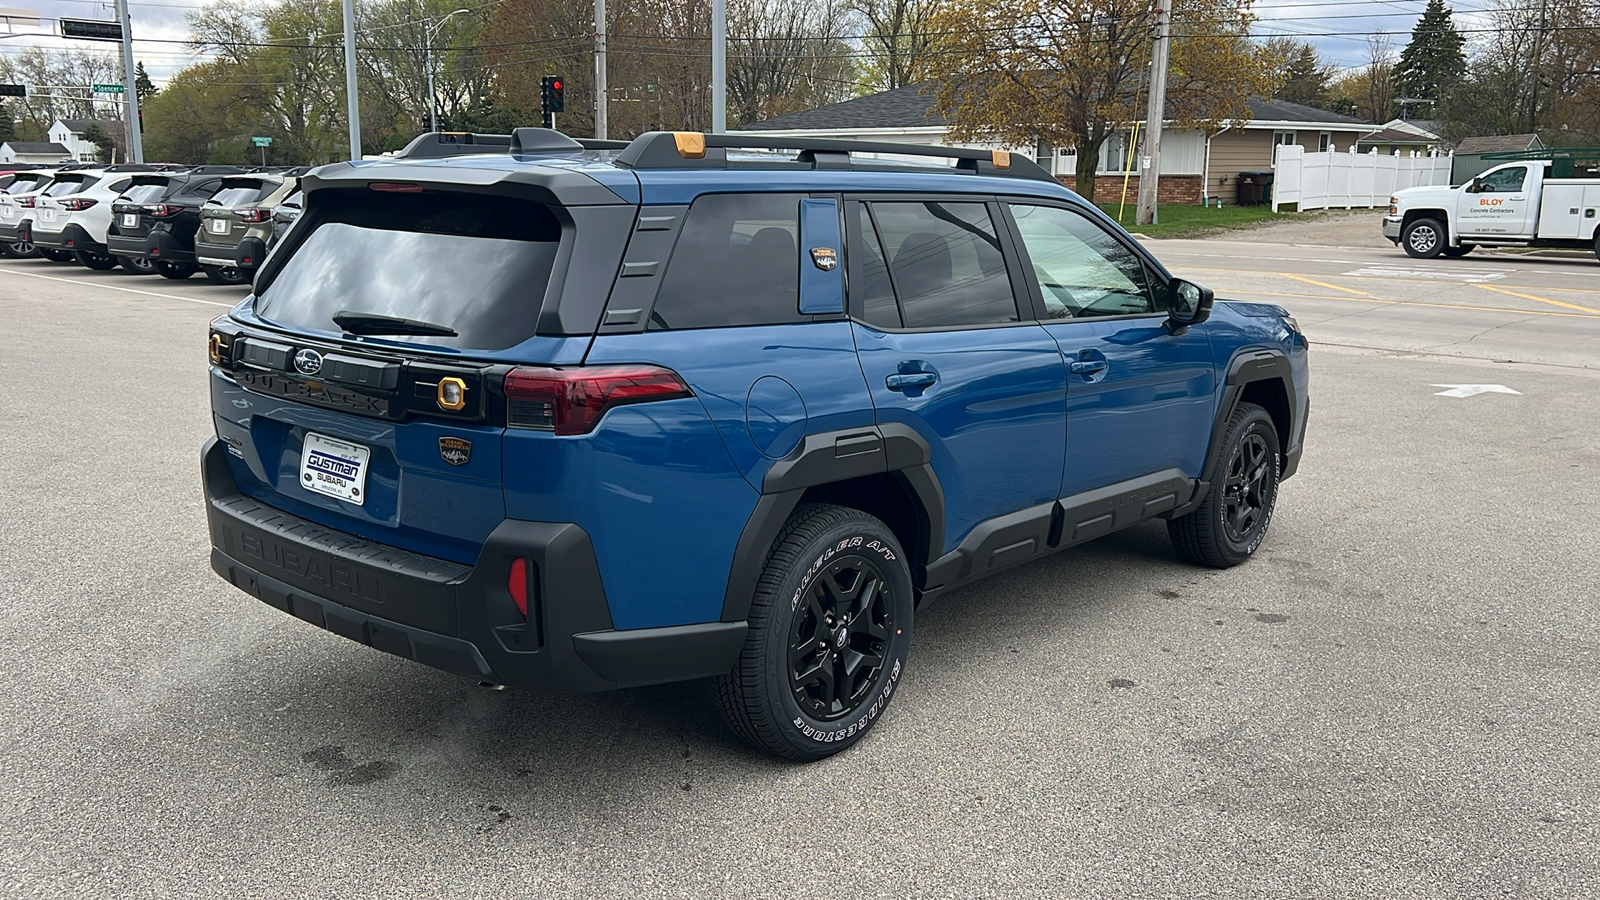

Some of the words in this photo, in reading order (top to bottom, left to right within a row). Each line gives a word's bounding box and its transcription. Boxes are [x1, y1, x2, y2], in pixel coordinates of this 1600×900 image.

[243, 371, 387, 415] OUTBACK
[317, 473, 346, 488] SUBARU
[241, 530, 386, 604] SUBARU
[791, 536, 864, 612] DUELER
[866, 540, 896, 562] A/T
[792, 658, 902, 743] BRIDGESTONE
